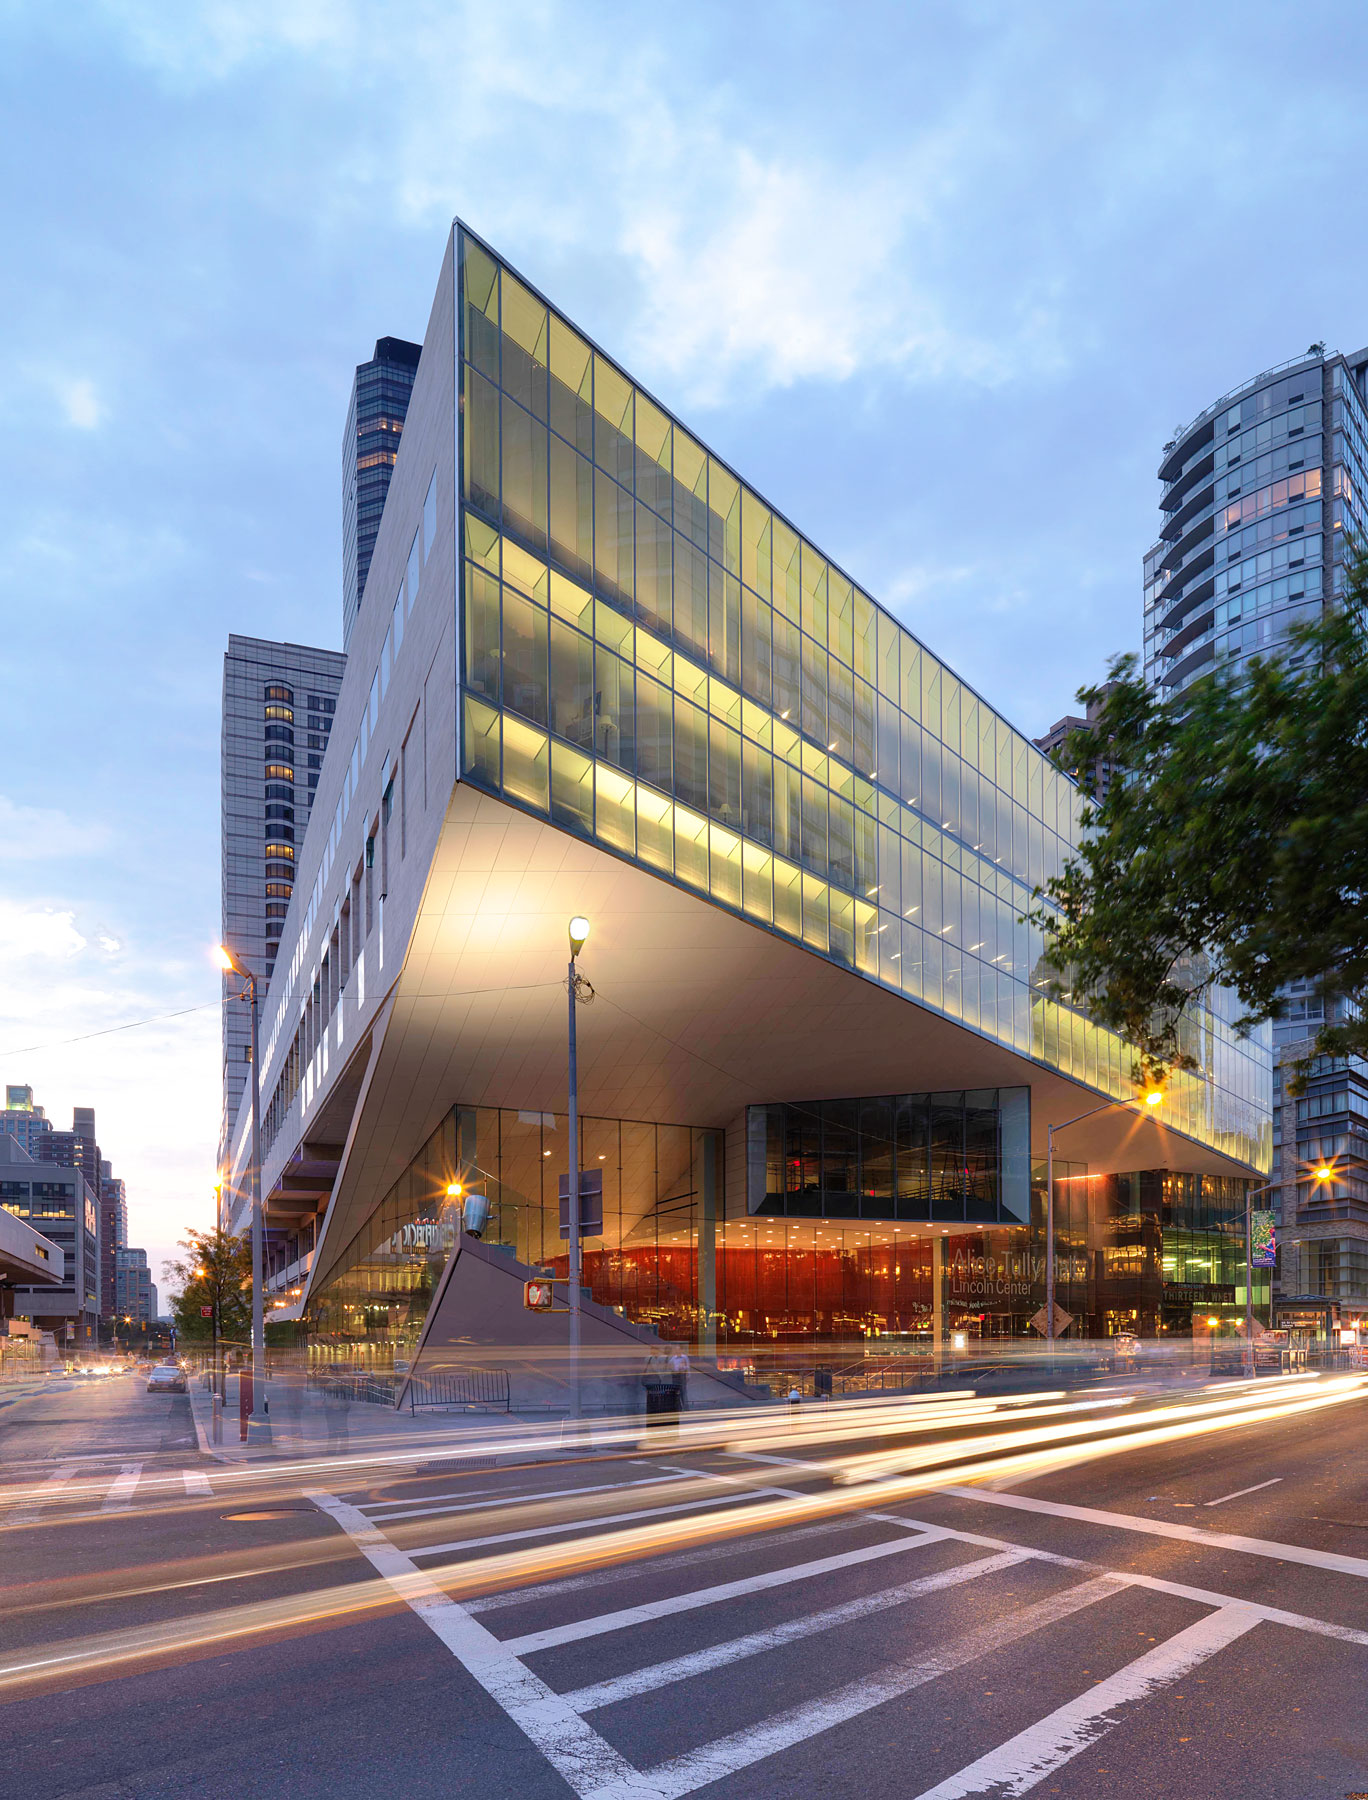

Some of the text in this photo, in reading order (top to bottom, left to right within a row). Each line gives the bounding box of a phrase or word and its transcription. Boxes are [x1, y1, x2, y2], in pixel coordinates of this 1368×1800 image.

[952, 1248, 996, 1275] Alice
[1000, 1251, 1041, 1282] Tully
[952, 1278, 1032, 1295] Lincoln Center
[1163, 1290, 1205, 1302] THIRTEEN
